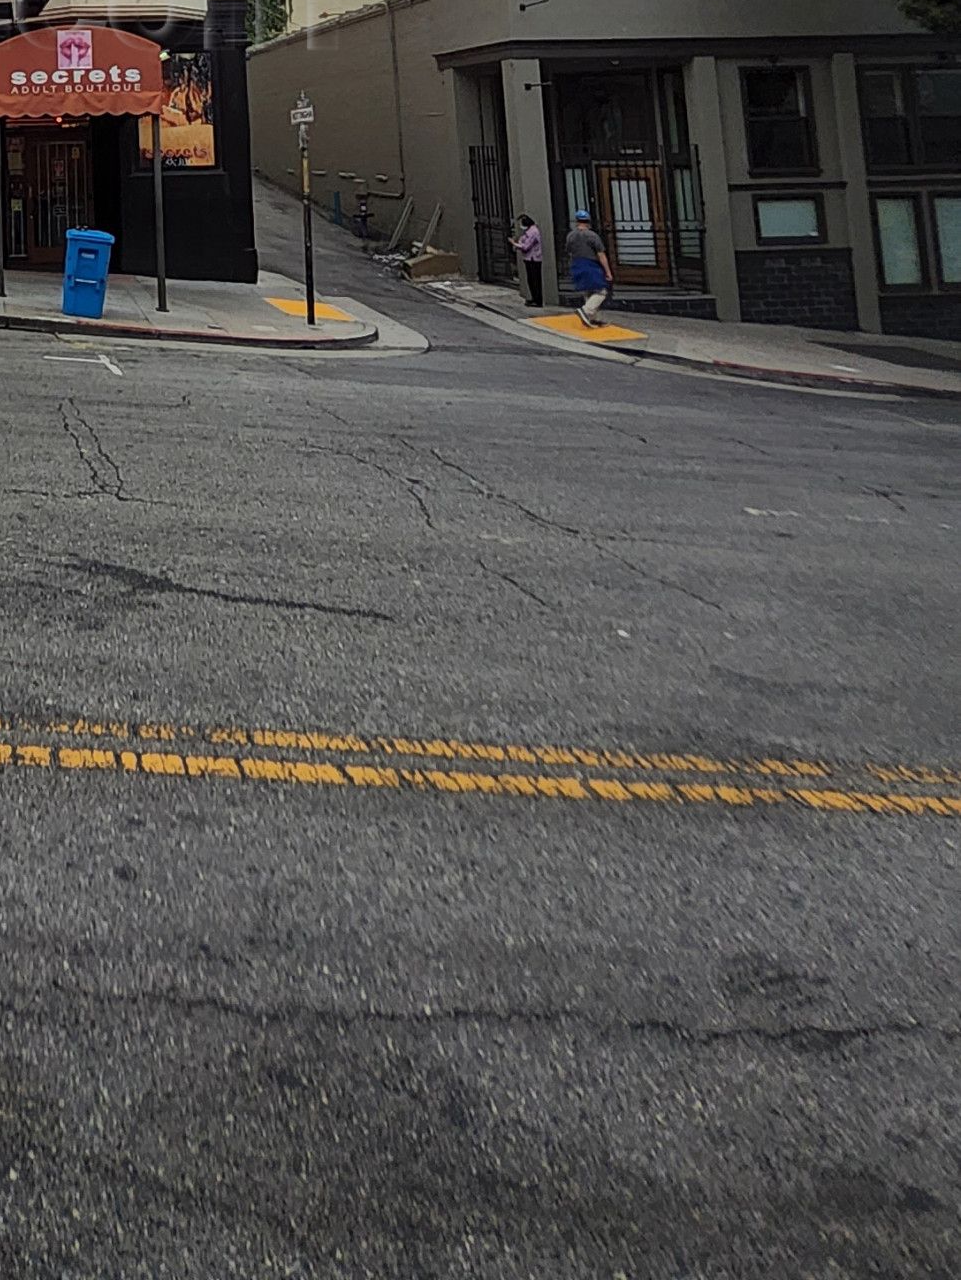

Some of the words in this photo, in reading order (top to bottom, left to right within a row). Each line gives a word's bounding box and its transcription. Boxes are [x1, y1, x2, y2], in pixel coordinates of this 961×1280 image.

[10, 65, 141, 85] secrets
[10, 85, 57, 94] ADULT
[64, 83, 141, 93] BOUTIQUE
